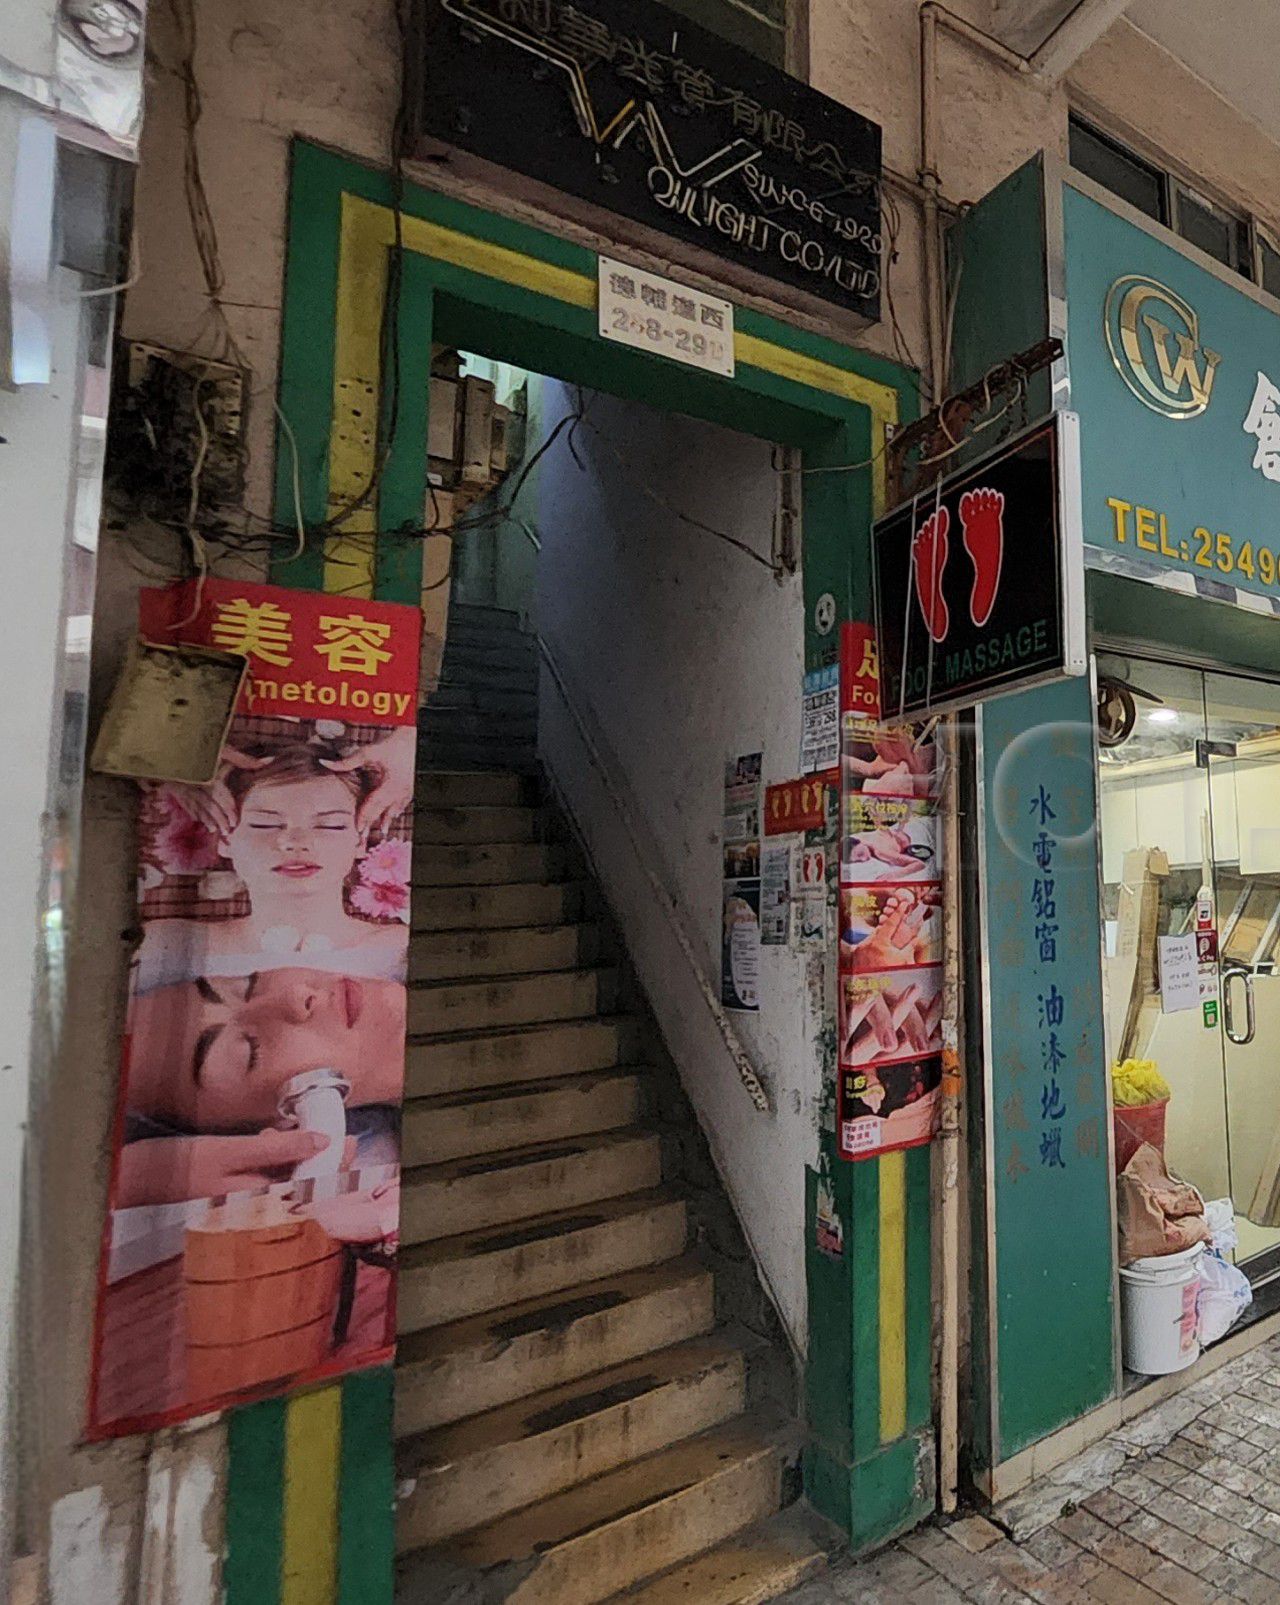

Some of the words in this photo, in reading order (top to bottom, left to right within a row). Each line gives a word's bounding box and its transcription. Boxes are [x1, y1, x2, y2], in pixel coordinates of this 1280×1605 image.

[211, 598, 393, 675] 美容
[945, 618, 1048, 683] MASSAGE
[244, 678, 411, 717] metology
[852, 684, 880, 706] Fo
